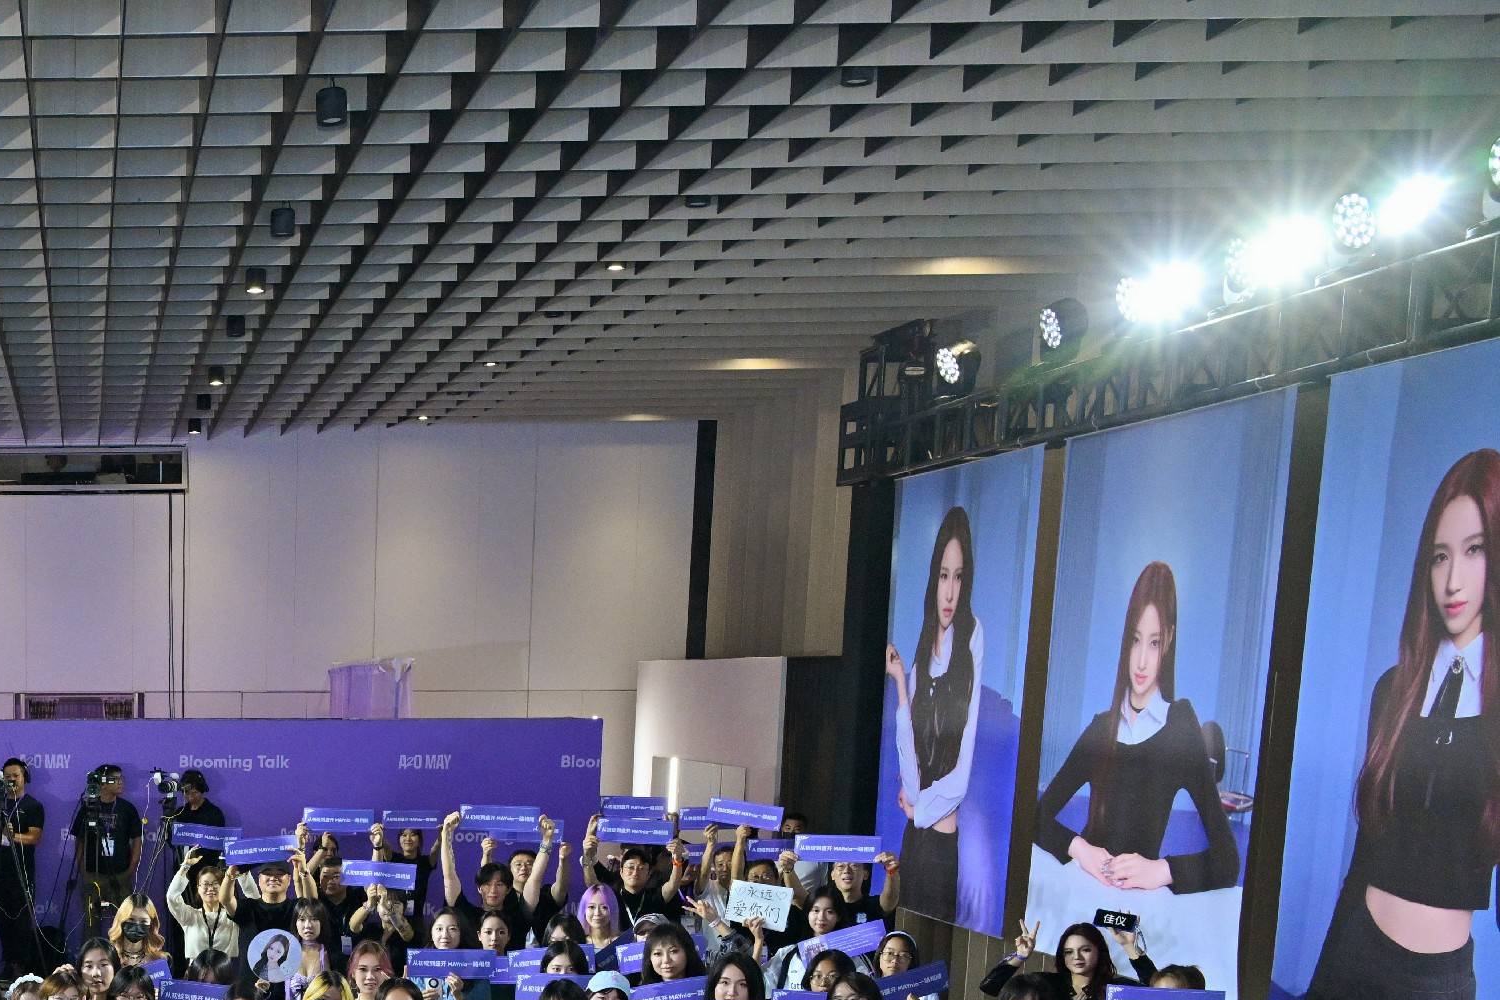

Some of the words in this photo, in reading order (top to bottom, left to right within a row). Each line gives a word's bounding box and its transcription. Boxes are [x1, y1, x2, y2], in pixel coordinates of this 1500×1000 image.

[44, 754, 71, 769] MAY
[179, 755, 253, 771] Blooming
[257, 755, 290, 769] Talk
[425, 754, 452, 769] MAY
[747, 886, 773, 901] 永远
[733, 901, 781, 924] 爱你们
[1103, 913, 1126, 927] 佳仪
